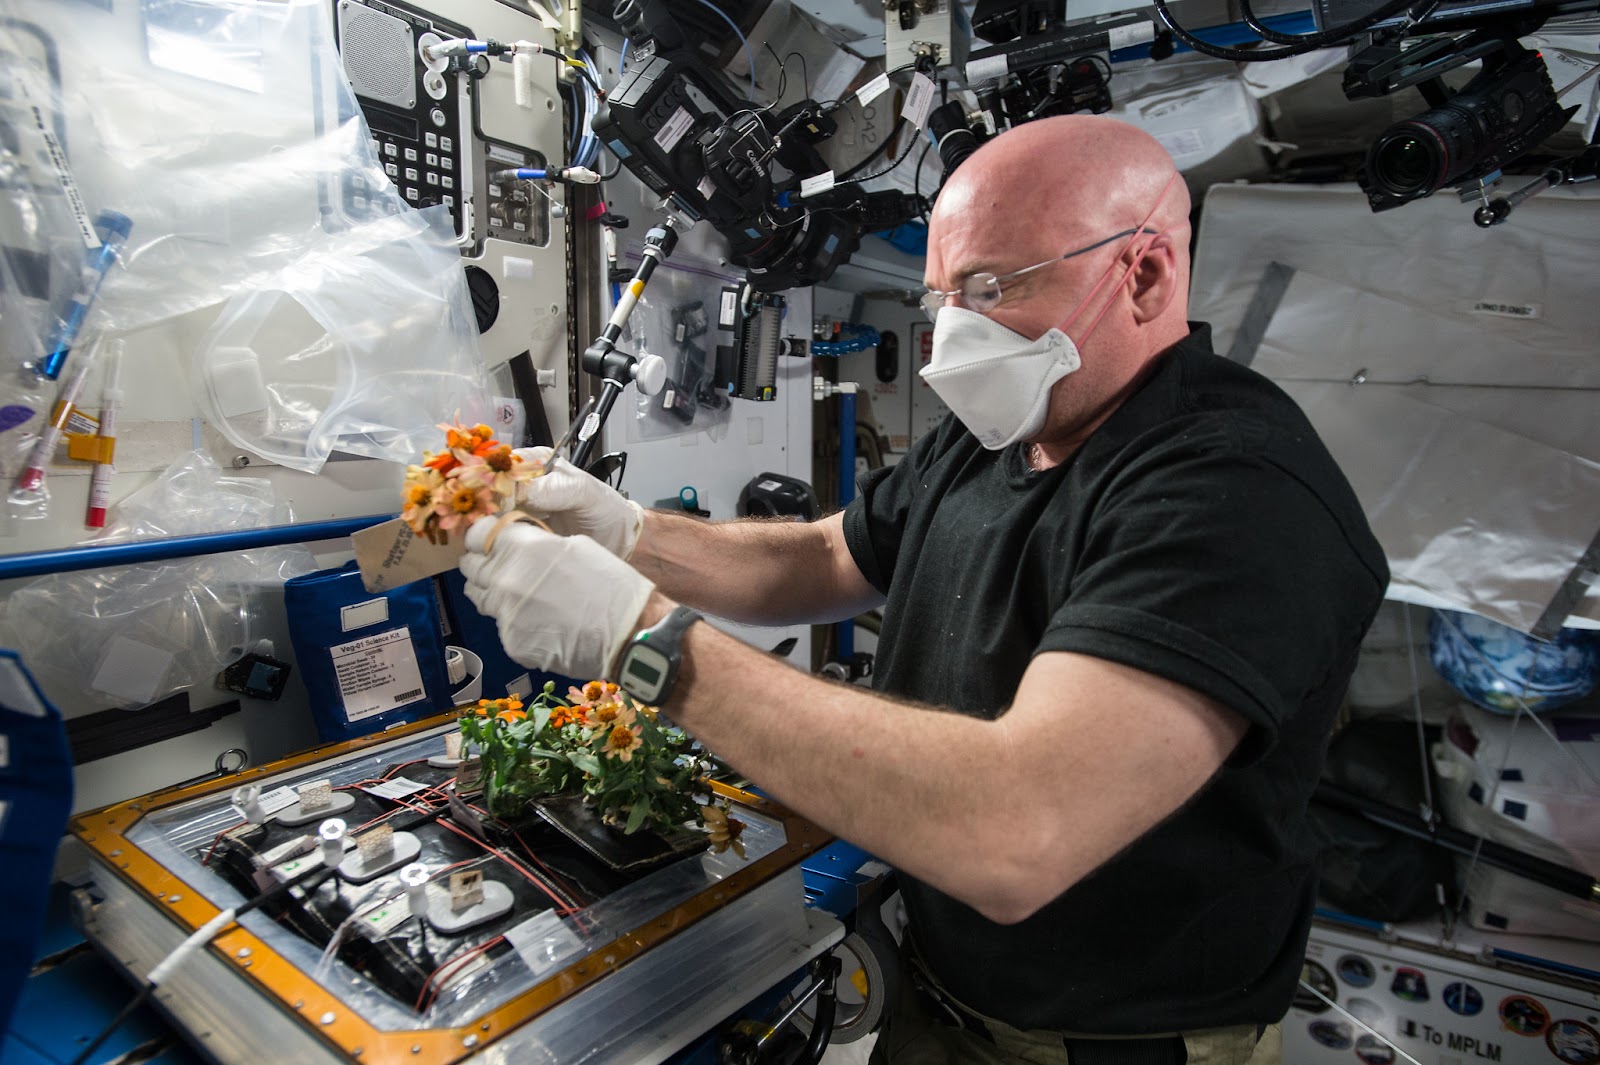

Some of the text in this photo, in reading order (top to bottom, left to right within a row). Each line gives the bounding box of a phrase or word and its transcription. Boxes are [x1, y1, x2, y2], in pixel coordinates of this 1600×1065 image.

[746, 148, 766, 178] Canon
[340, 642, 364, 653] Veg-01
[365, 636, 389, 646] Science
[1423, 1024, 1502, 1062] To MPLM
